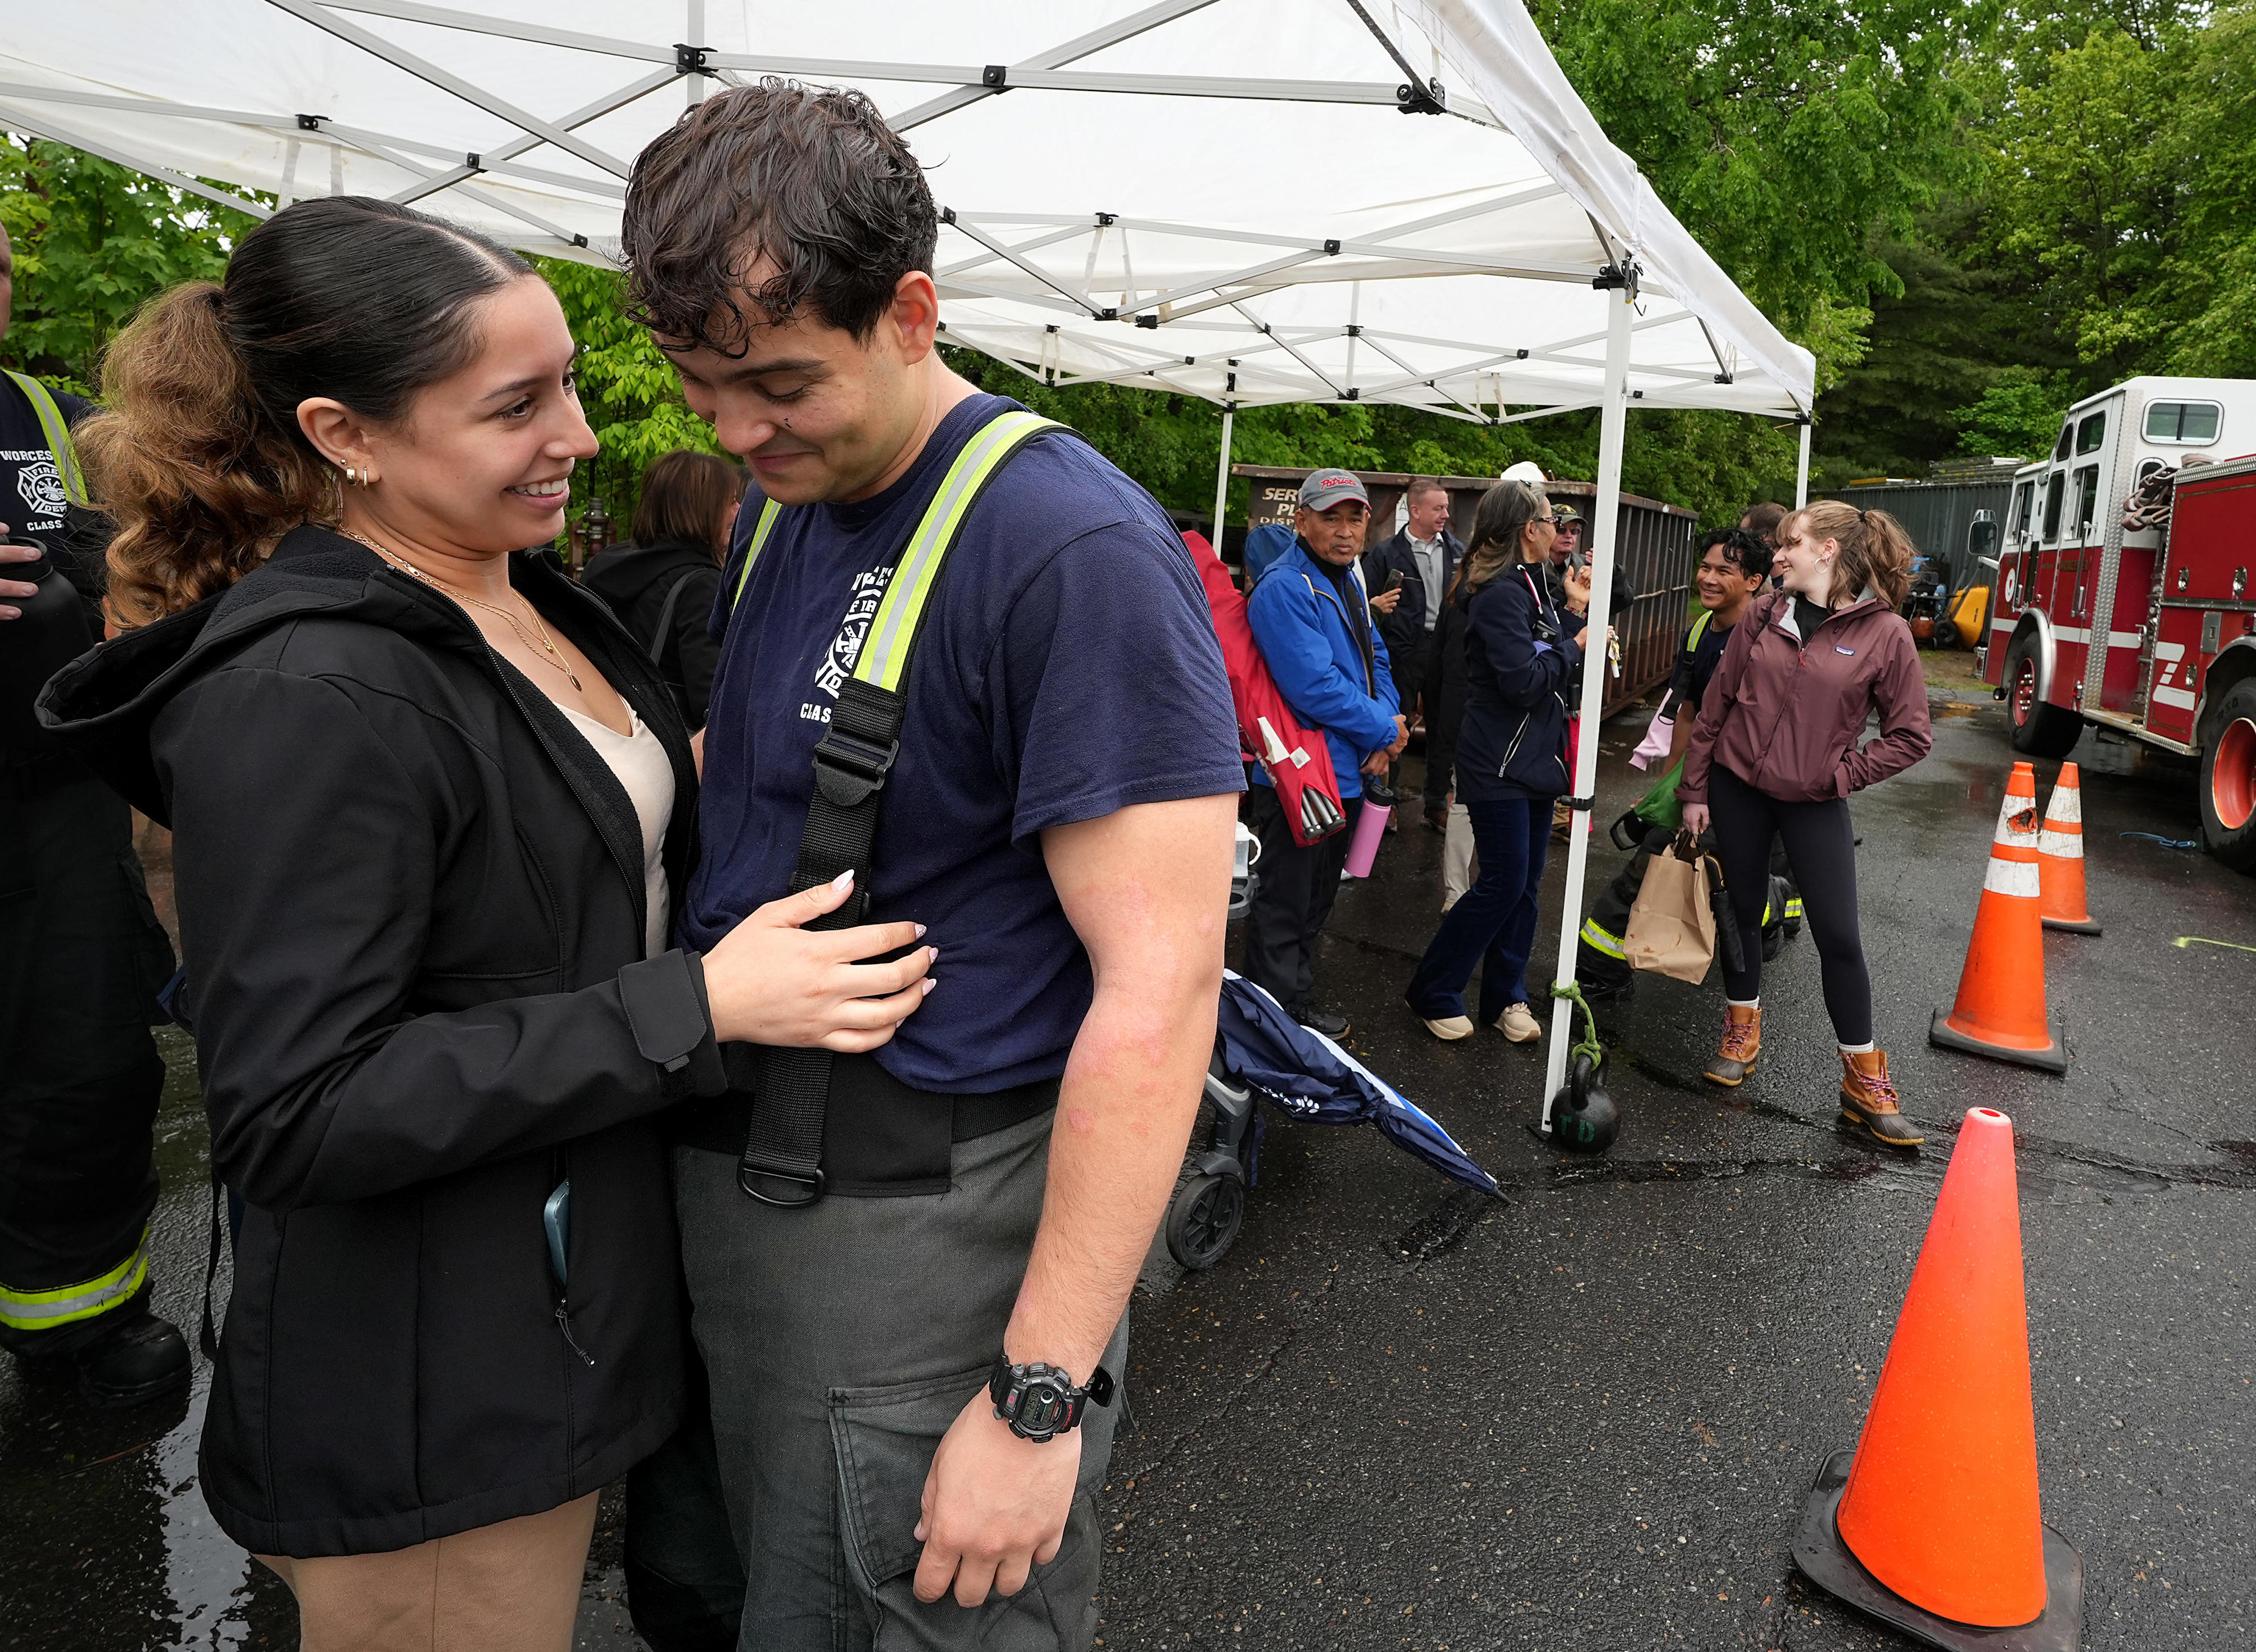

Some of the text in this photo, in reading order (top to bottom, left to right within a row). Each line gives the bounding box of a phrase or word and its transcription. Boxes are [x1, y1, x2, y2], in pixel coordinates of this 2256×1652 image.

[31, 467, 58, 476] FIRE
[1262, 487, 1298, 501] SER
[800, 703, 832, 723] CLAS
